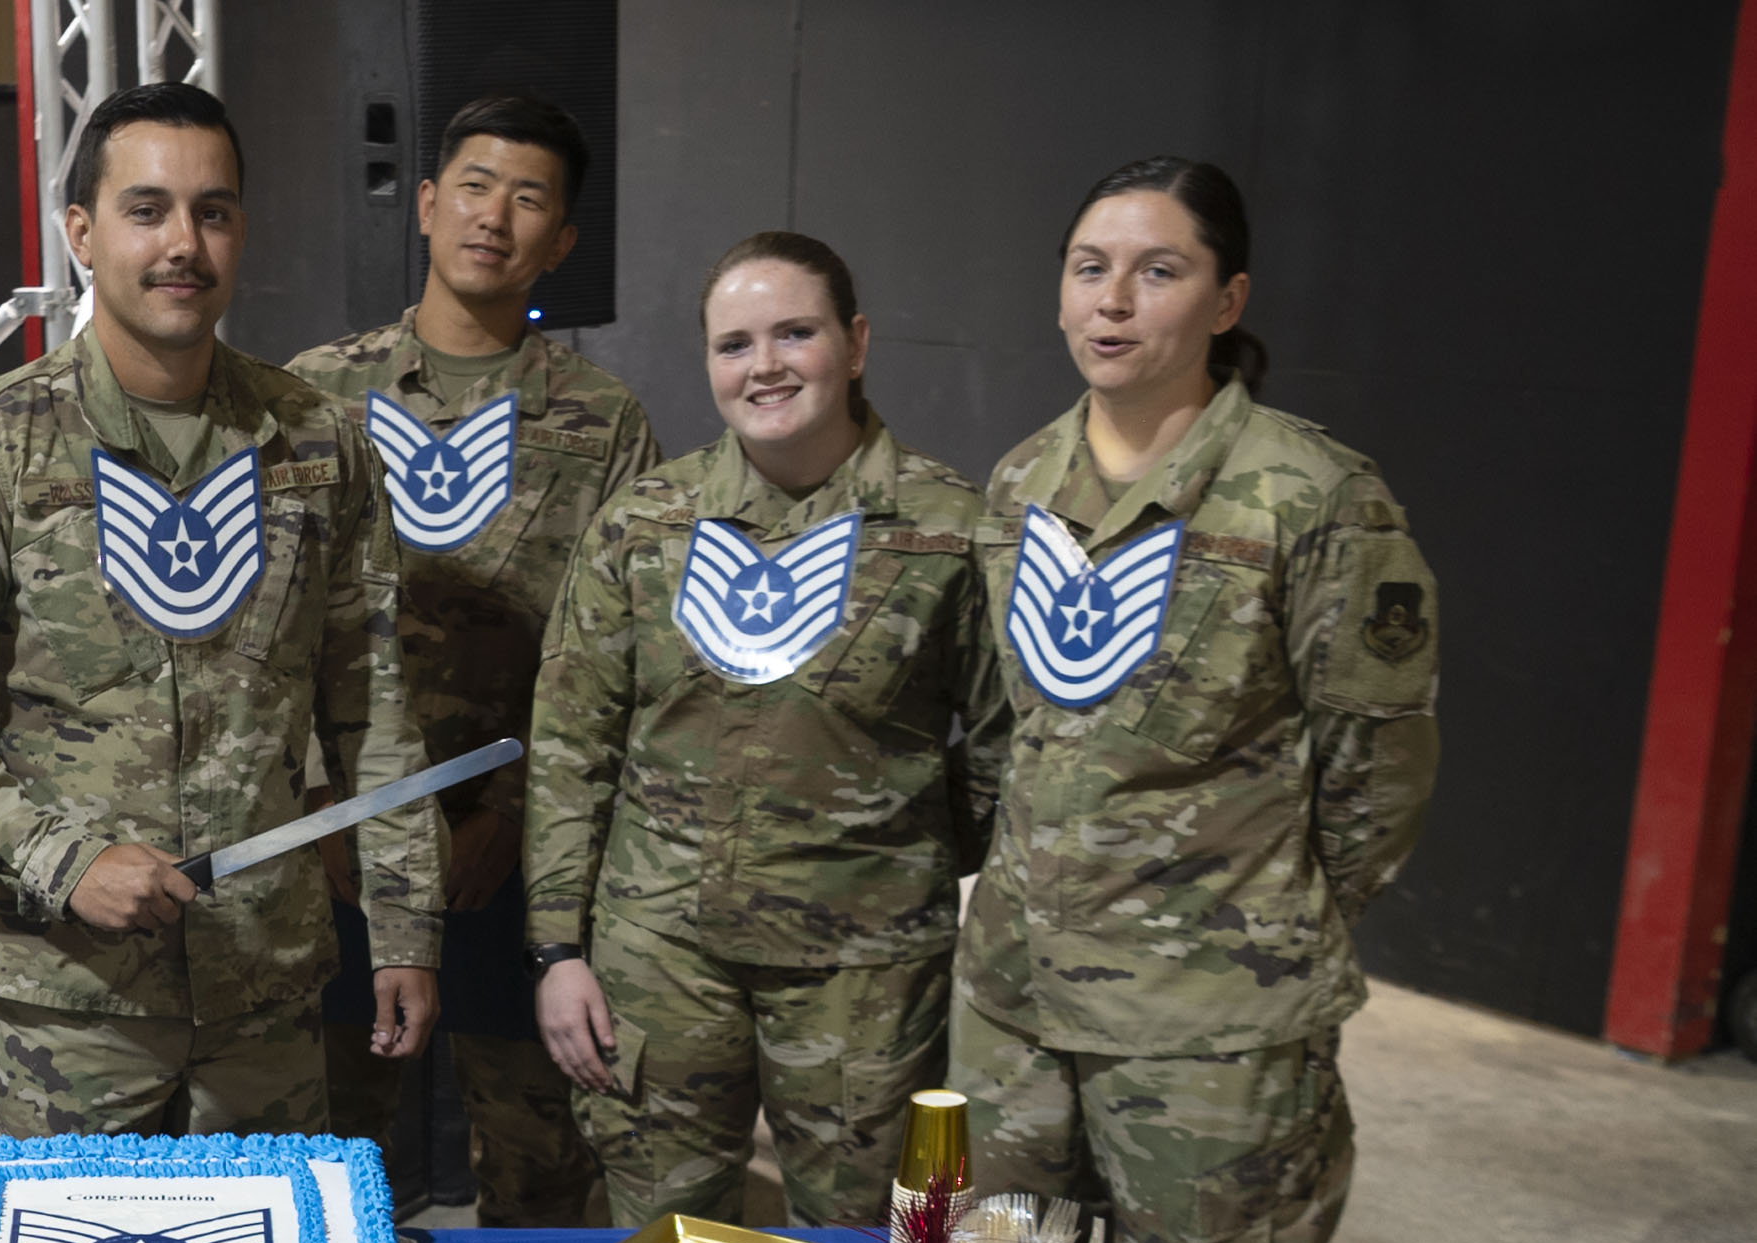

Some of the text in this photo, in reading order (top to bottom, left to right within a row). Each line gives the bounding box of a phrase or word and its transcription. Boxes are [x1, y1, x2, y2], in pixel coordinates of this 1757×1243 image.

[554, 431, 600, 456] FORCE
[265, 462, 331, 489] AIR FORCE
[49, 482, 93, 503] WASS
[65, 1193, 216, 1202] Congratulation
